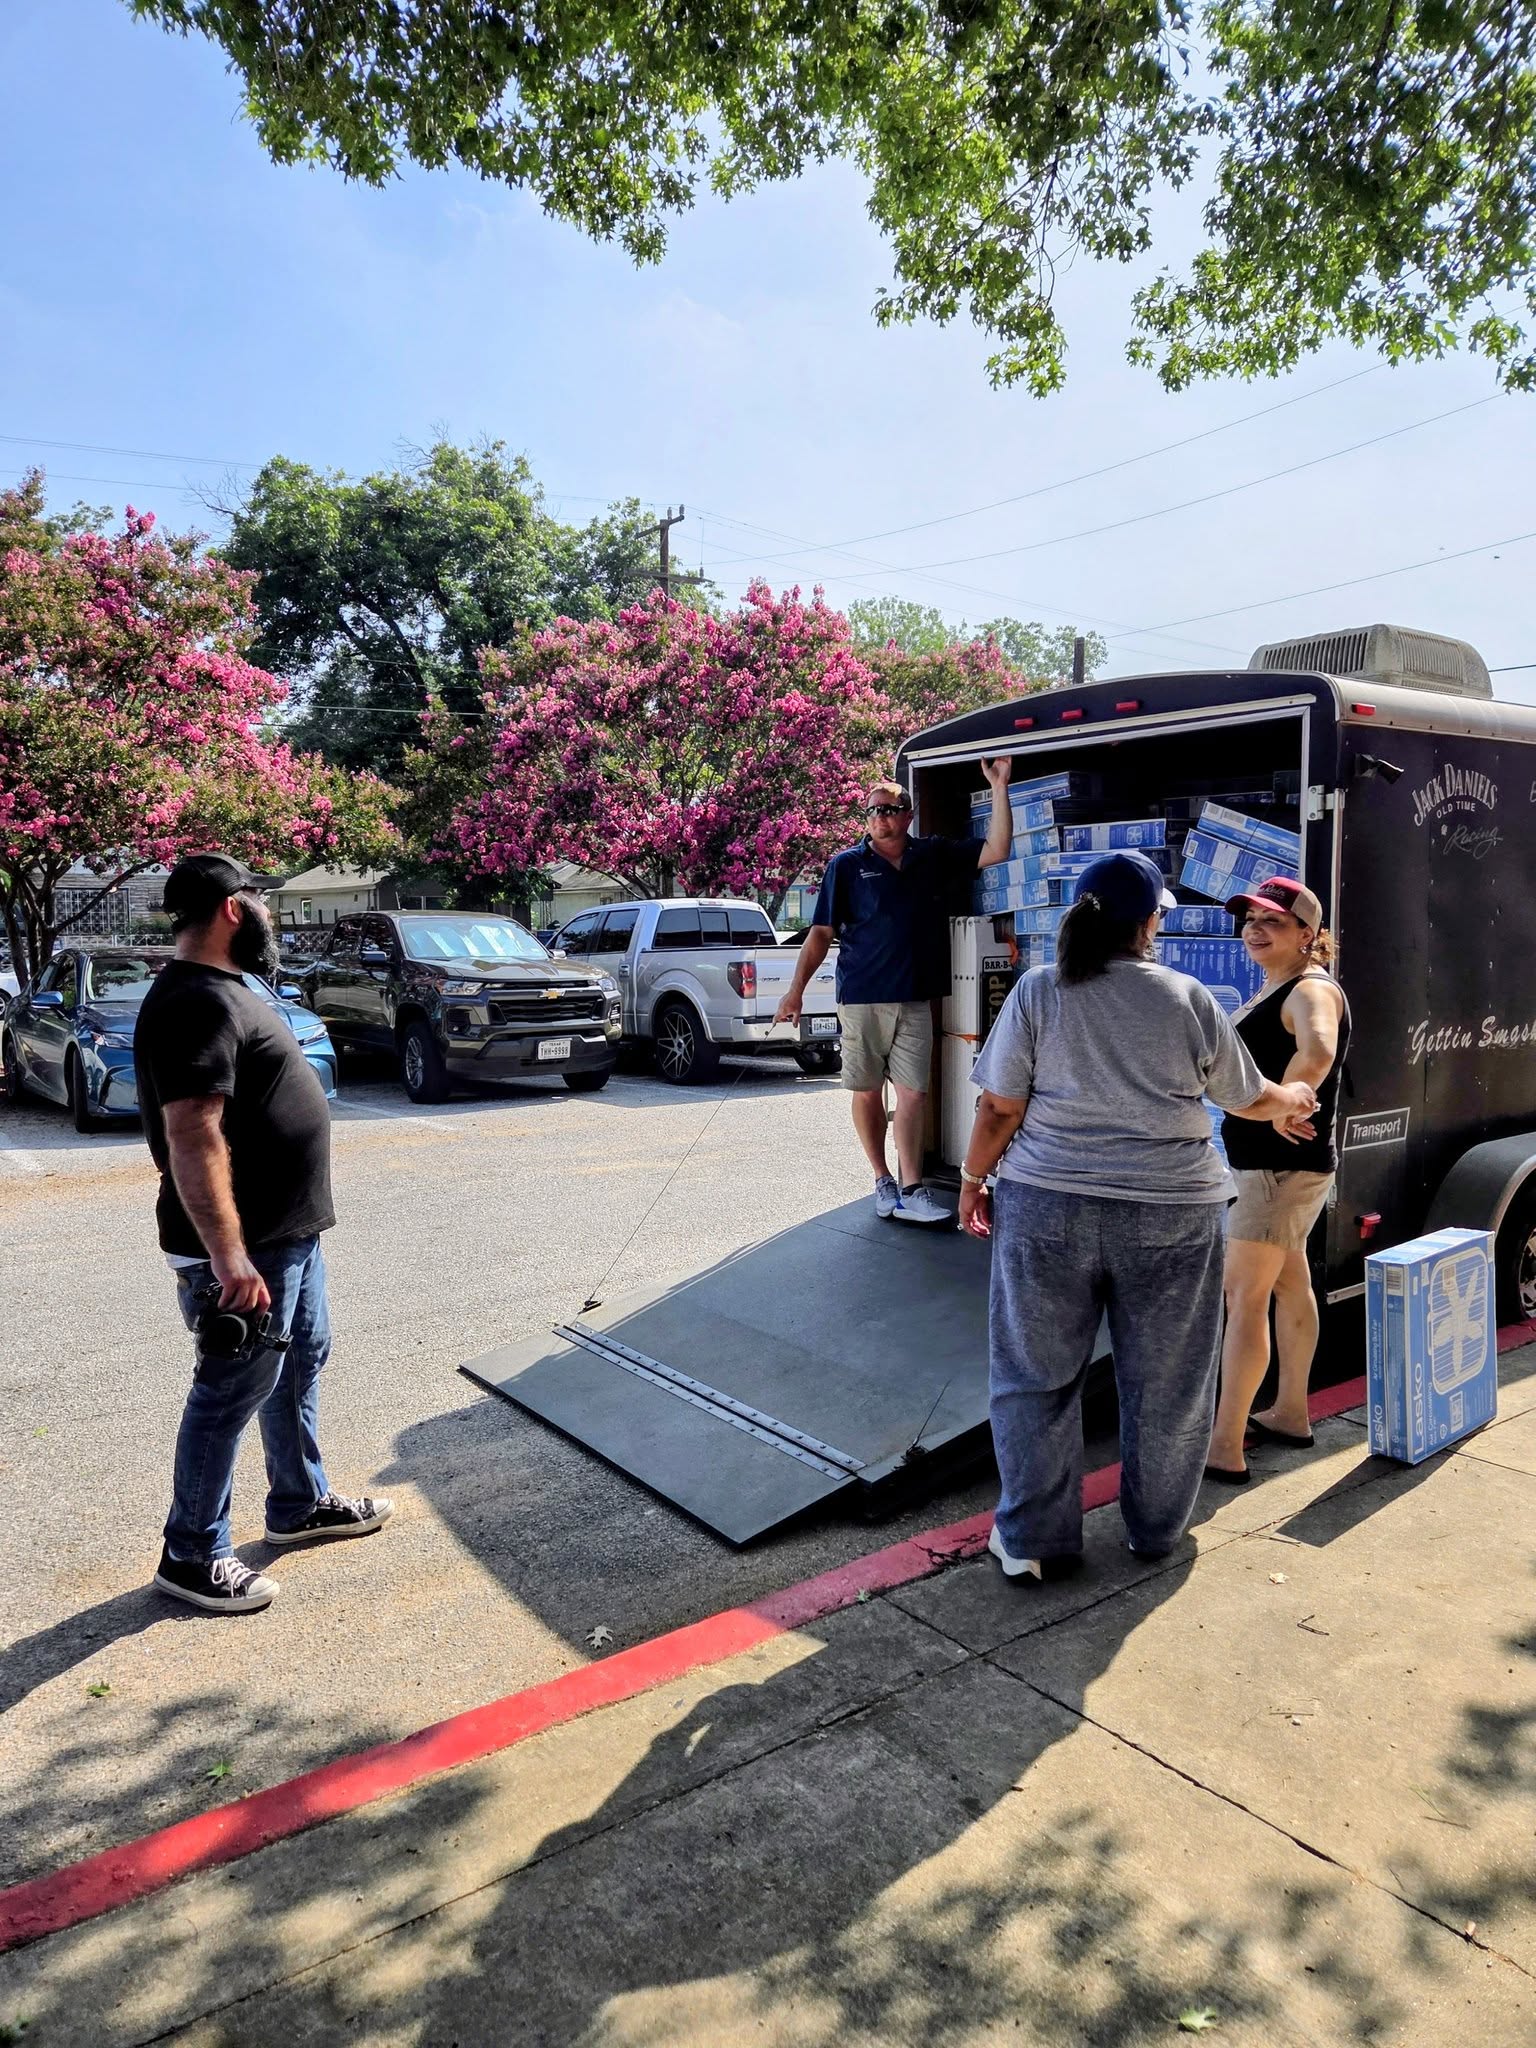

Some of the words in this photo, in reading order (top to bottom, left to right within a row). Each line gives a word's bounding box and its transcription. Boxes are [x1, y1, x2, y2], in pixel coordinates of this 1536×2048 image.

[1411, 775, 1445, 827] JACK
[1436, 803, 1453, 819] OLD
[1456, 801, 1476, 812] TIME
[1443, 824, 1504, 859] Racing
[1352, 1117, 1401, 1140] Transport
[1372, 1404, 1384, 1452] Lasko
[1414, 1362, 1424, 1456] Lasko
